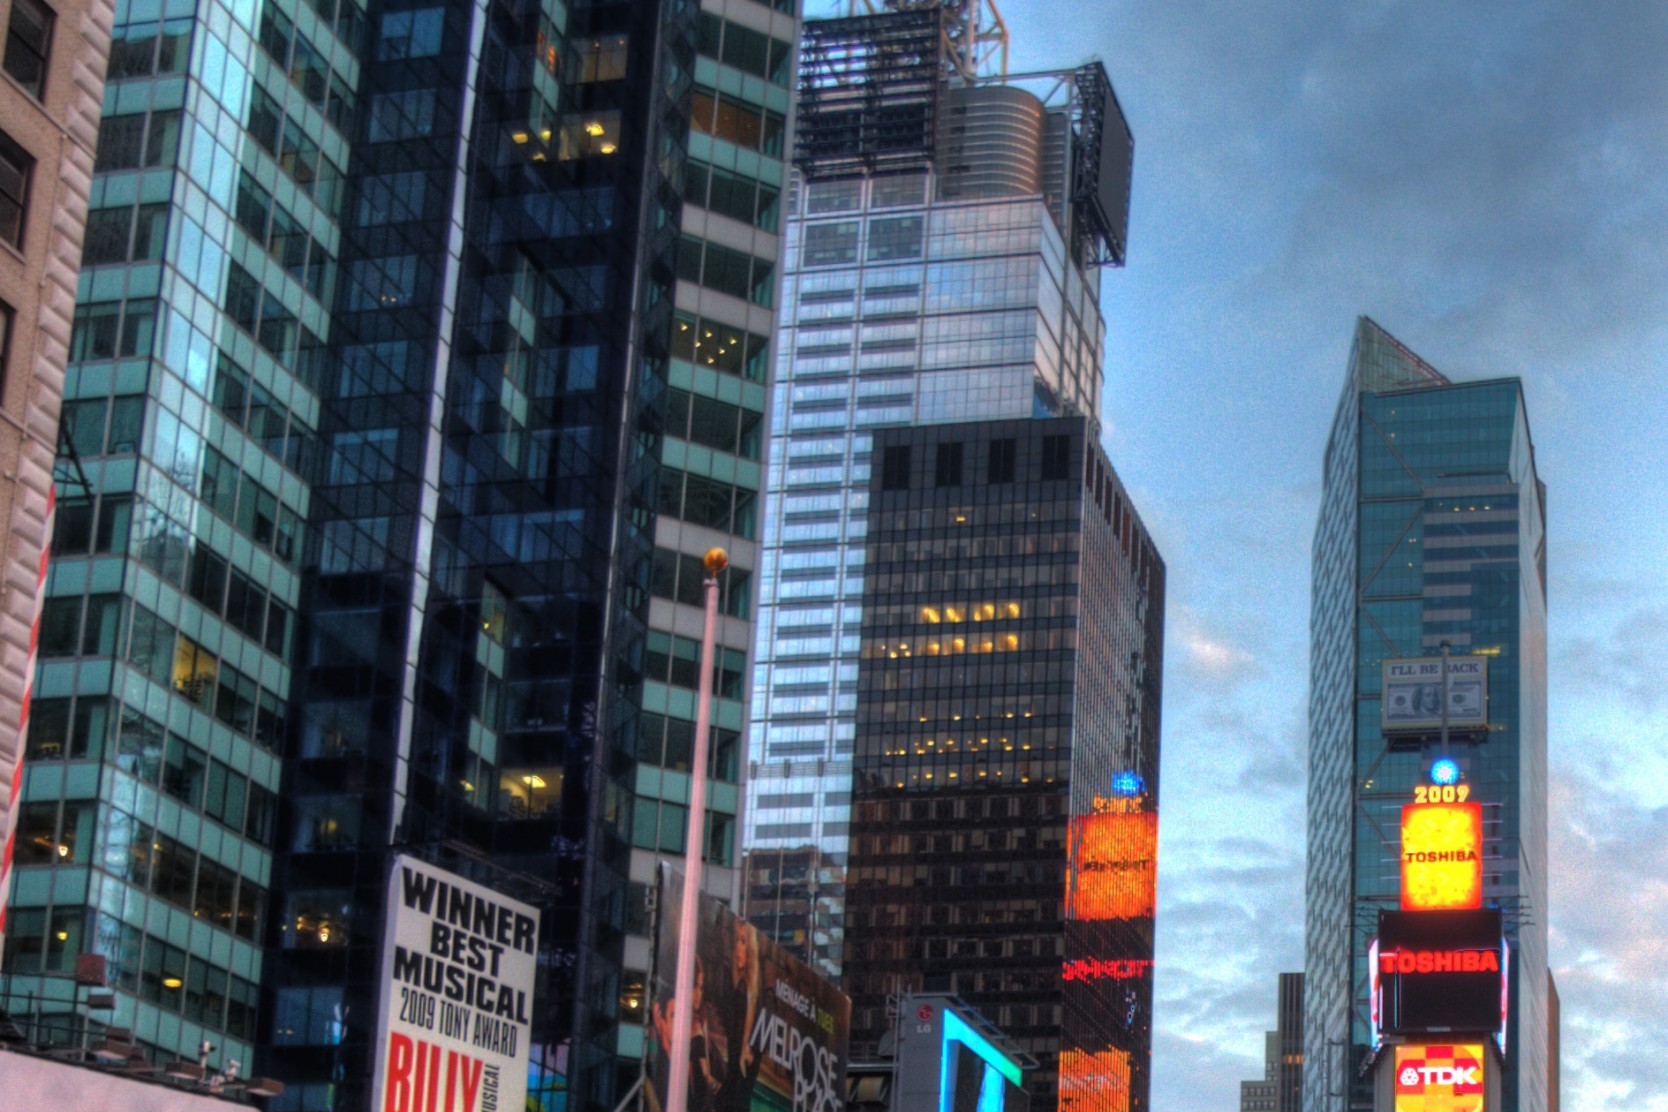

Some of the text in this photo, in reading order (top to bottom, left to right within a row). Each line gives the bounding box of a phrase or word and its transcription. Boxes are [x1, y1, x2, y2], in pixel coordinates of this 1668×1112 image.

[1390, 665, 1417, 676] I'LL
[1420, 663, 1439, 675] BE
[1414, 784, 1470, 804] 2009
[1405, 850, 1478, 864] TOSHIBA
[401, 866, 536, 956] WINNER
[430, 920, 505, 979] BEST
[1380, 949, 1499, 974] TOSHIBA
[393, 945, 529, 1026] MUSICAL
[399, 987, 518, 1058] 2009 TONY AWARD
[917, 1024, 932, 1034] LG
[749, 1007, 839, 1100] MELROSE
[1418, 1066, 1479, 1086] TDK
